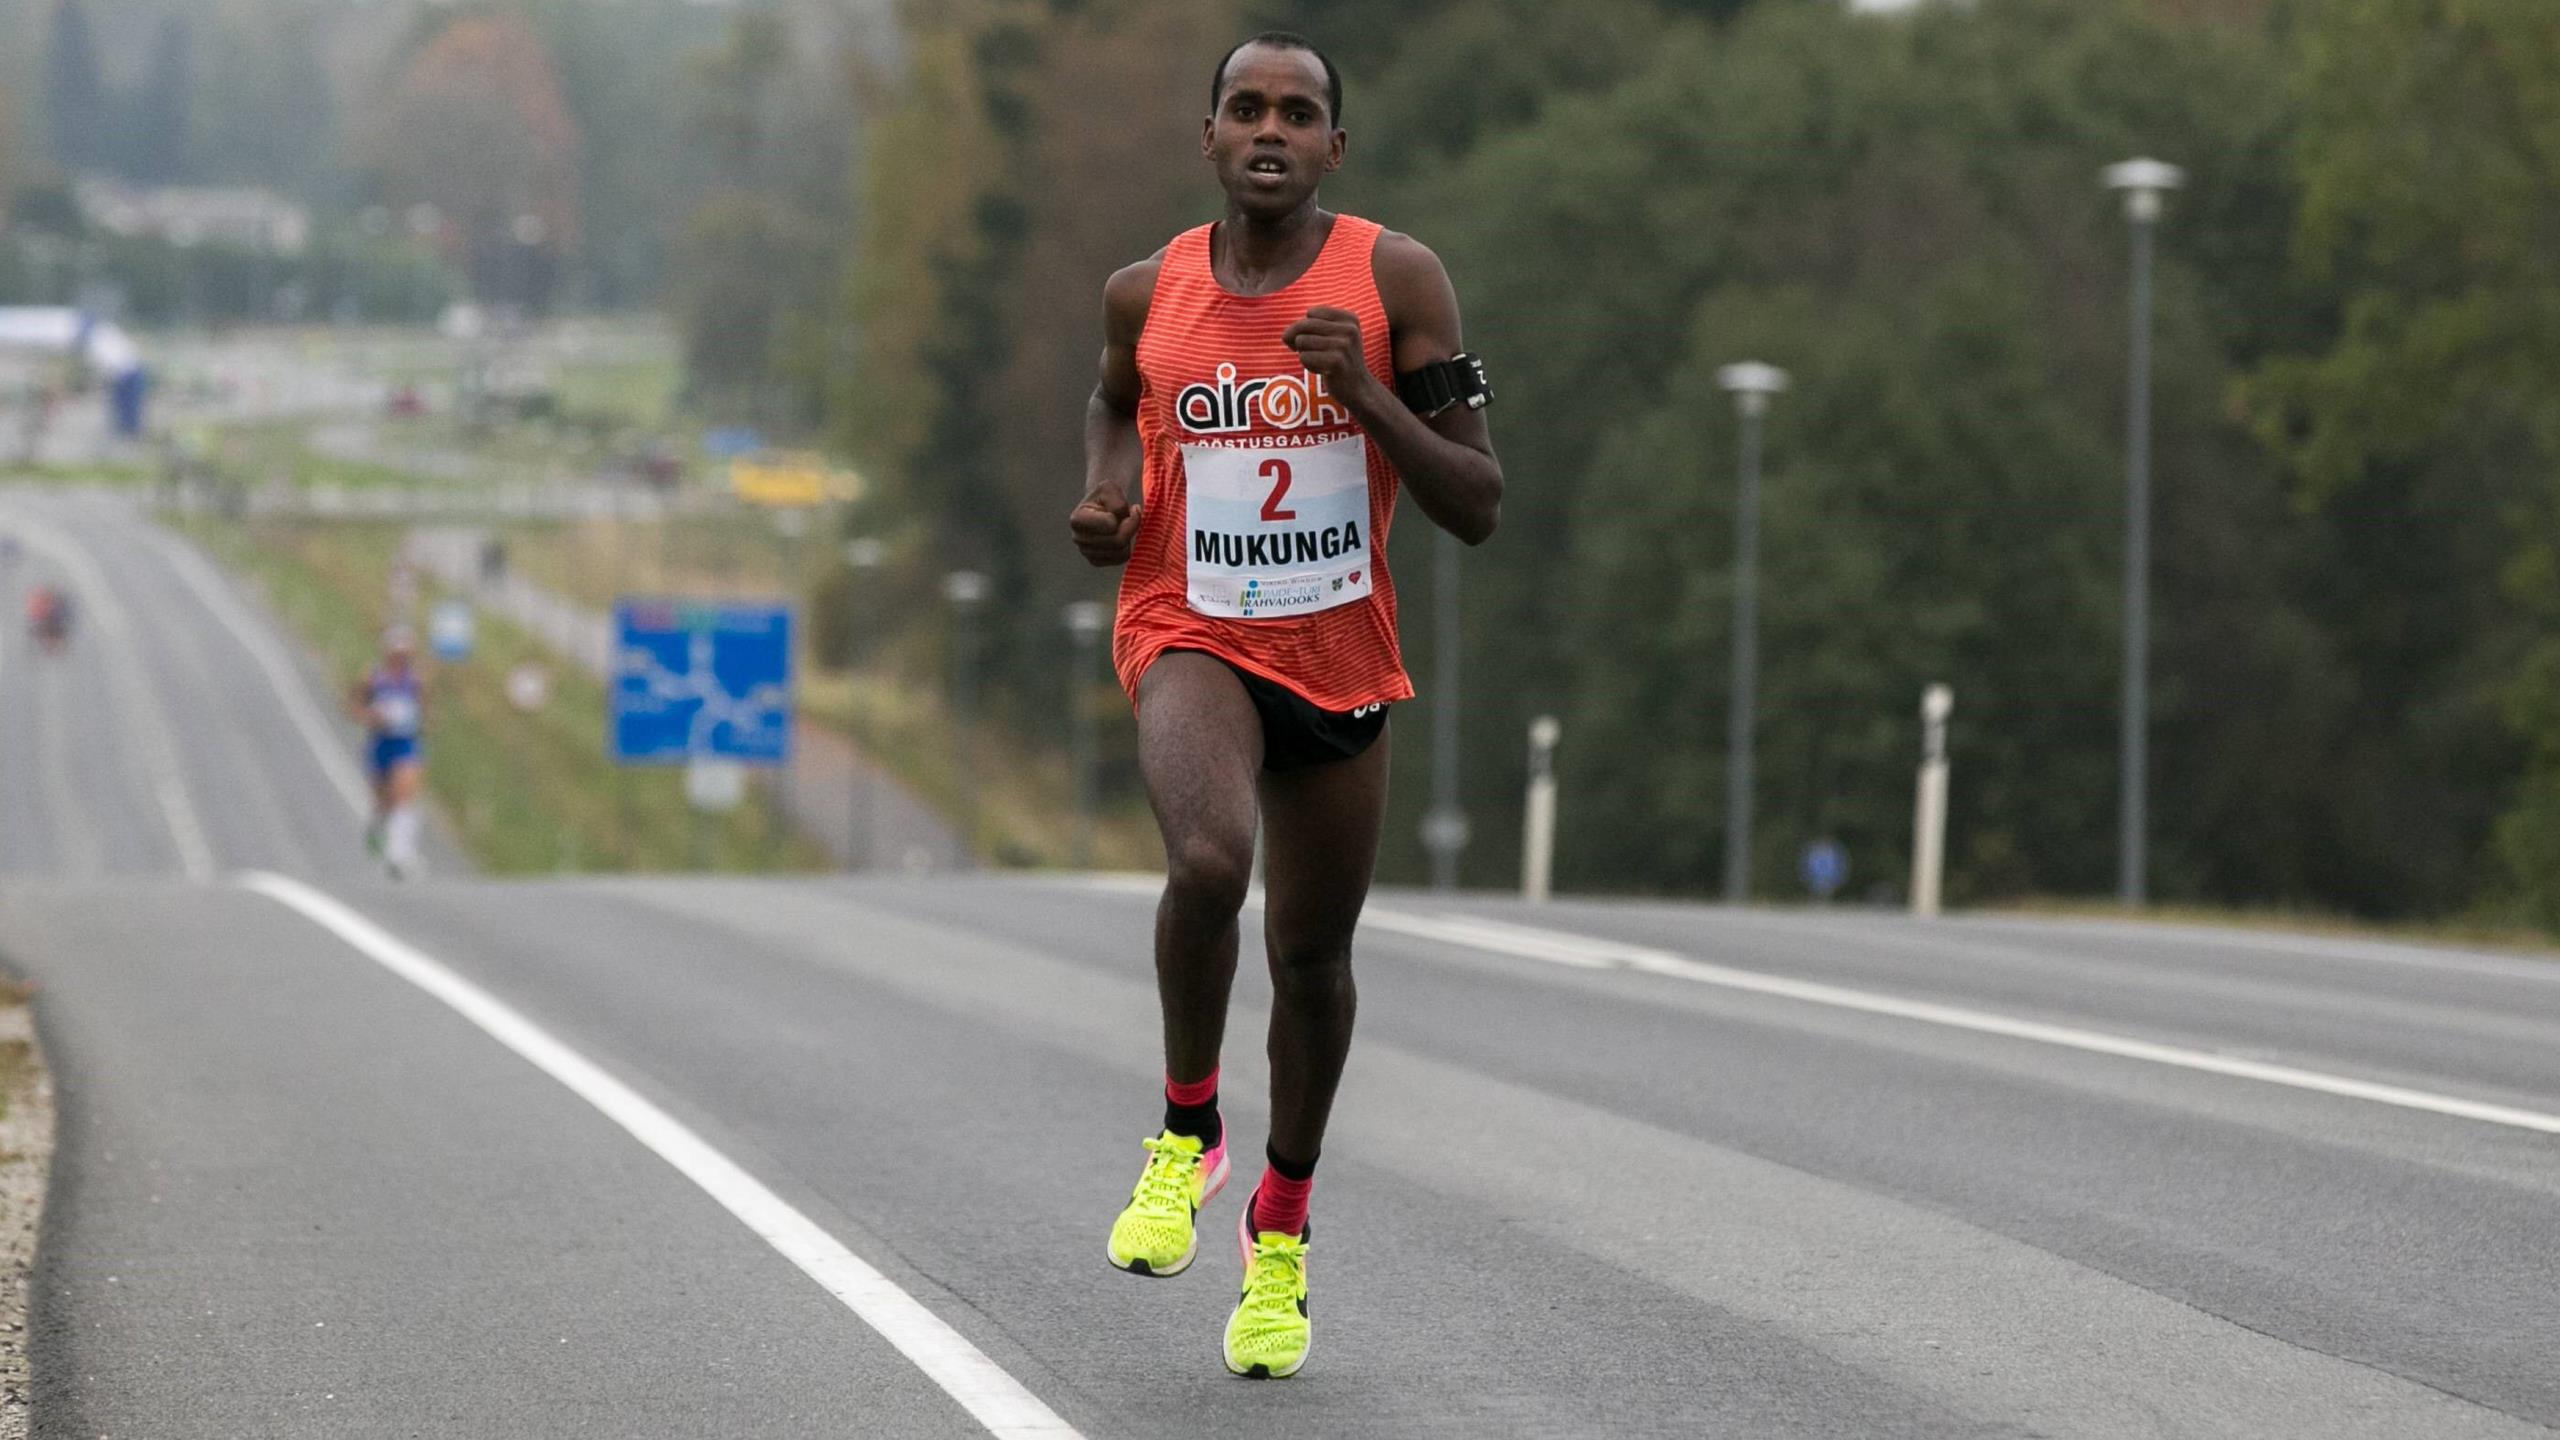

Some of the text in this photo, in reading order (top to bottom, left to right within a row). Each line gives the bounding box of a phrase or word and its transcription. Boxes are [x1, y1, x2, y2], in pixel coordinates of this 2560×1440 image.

[1182, 432, 1349, 449] ÖÖSTUSGAASID
[1258, 458, 1296, 522] 2
[1194, 520, 1361, 567] MUKUNGA
[1244, 594, 1320, 608] RAHVAJOOKS
